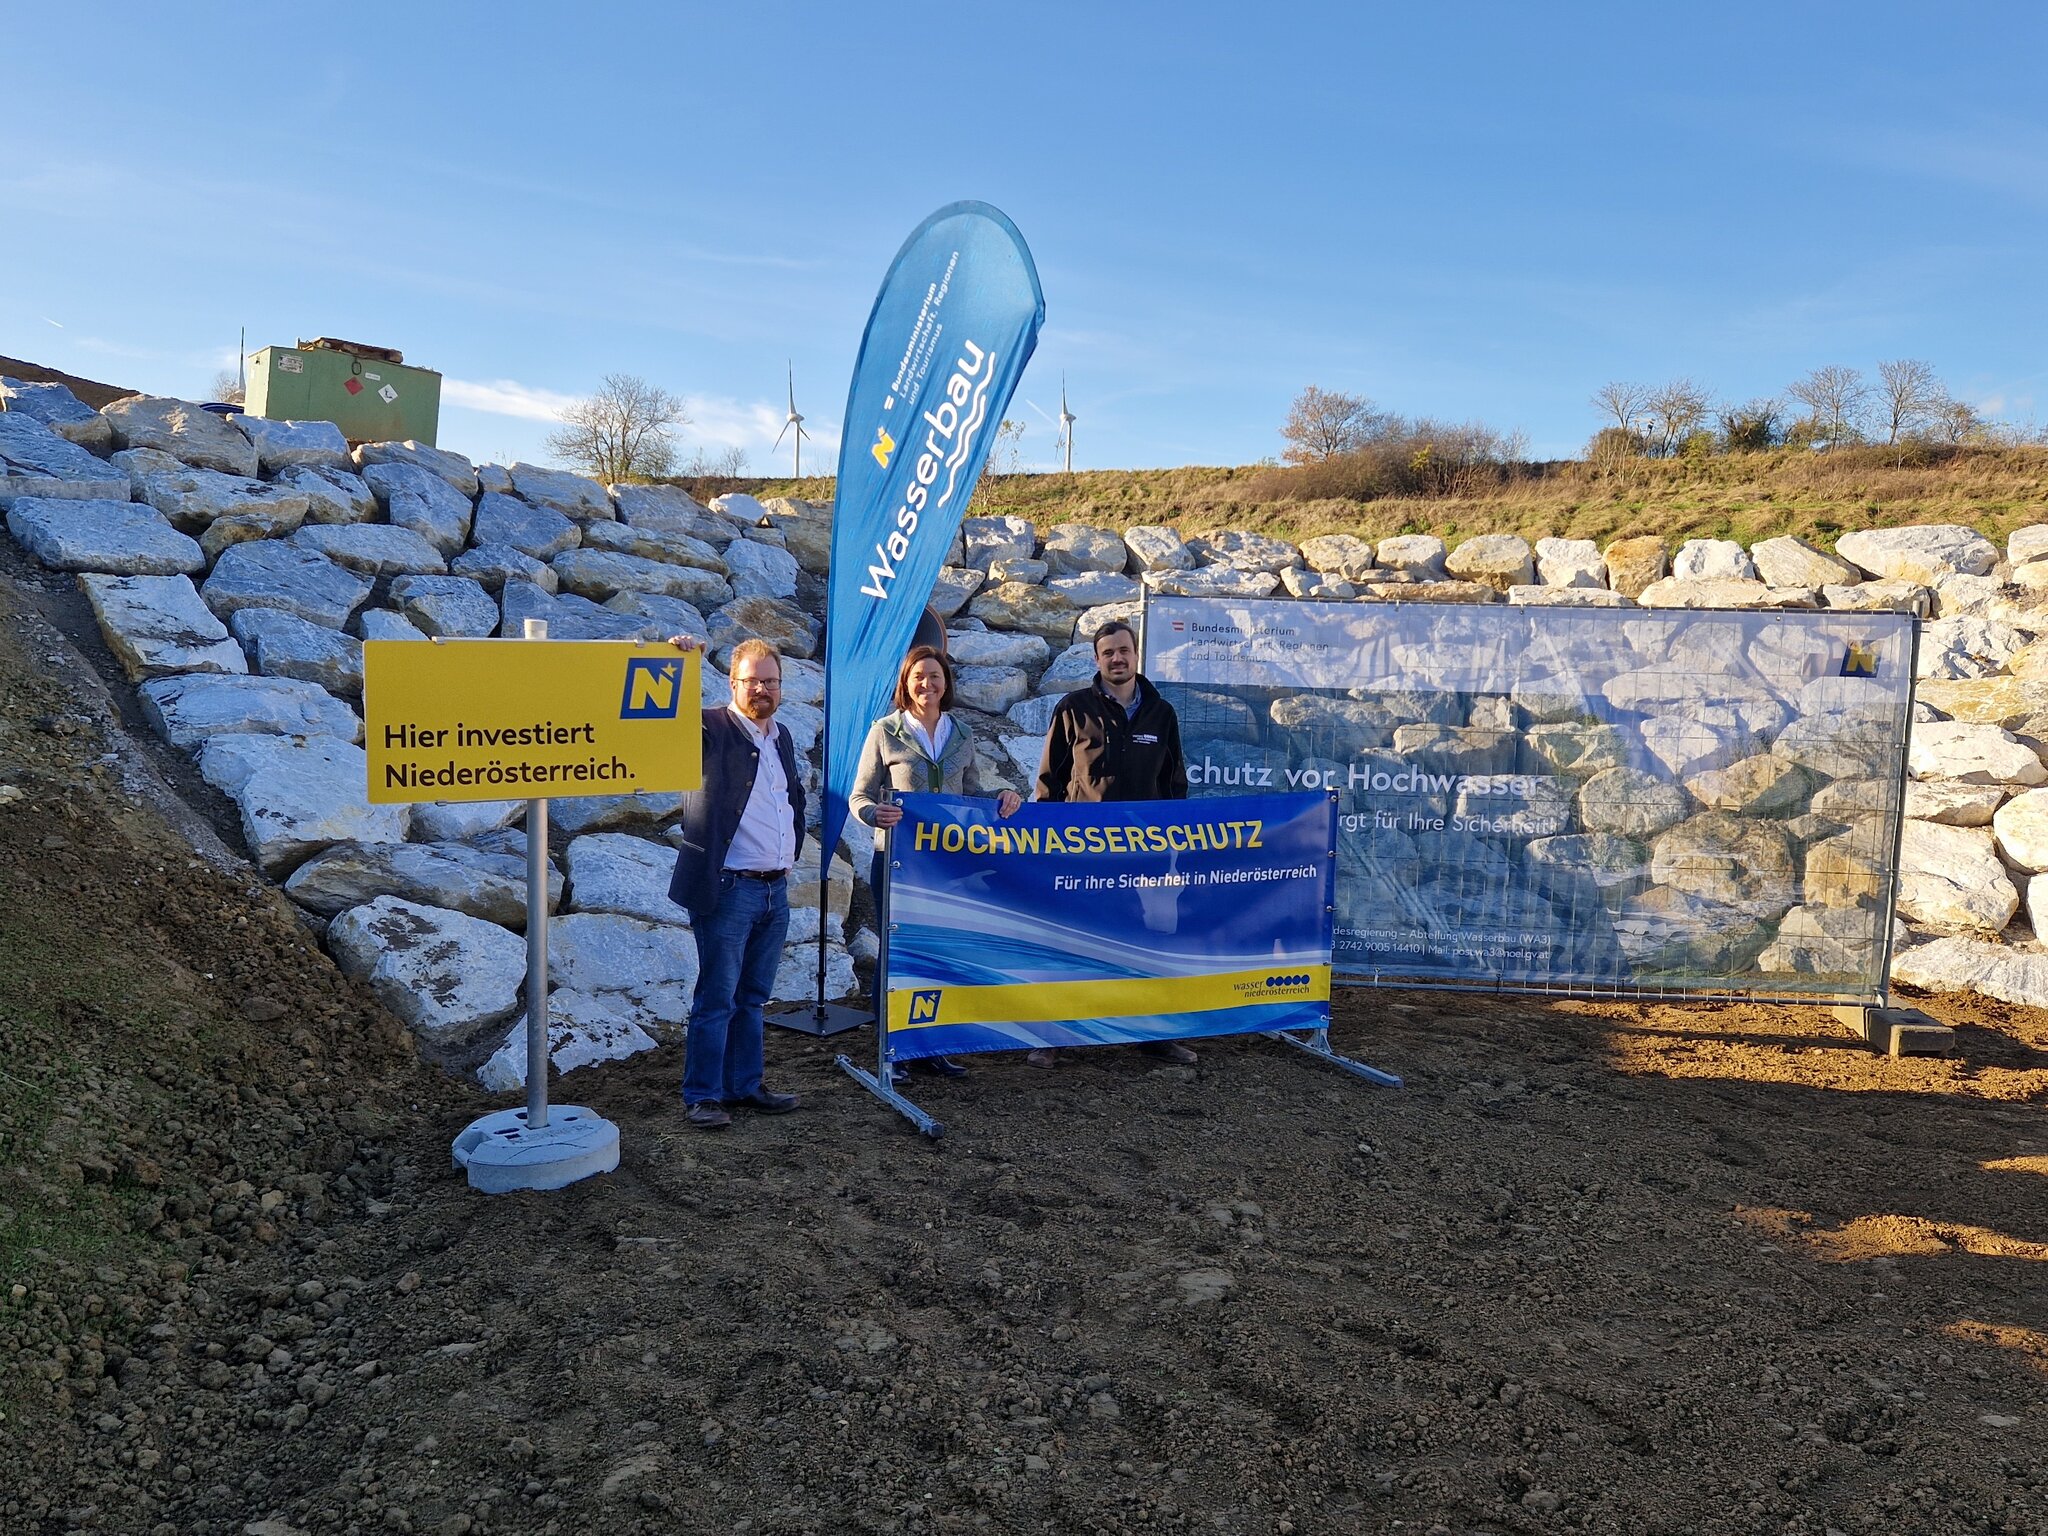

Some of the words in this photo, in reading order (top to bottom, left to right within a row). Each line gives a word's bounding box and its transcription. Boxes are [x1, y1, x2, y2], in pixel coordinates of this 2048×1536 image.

[892, 283, 937, 392] Bundesministerium
[899, 311, 939, 399] Landwirtschaft,
[933, 251, 959, 307] Regionen
[909, 381, 920, 405] und
[916, 323, 943, 379] Tourismus
[860, 339, 985, 600] Wasserbau
[384, 724, 449, 749] Hier
[457, 721, 596, 747] investiert
[385, 756, 637, 788] Niederösterreich.
[1186, 756, 1273, 787] chutz
[1285, 769, 1337, 790] vor
[1348, 763, 1543, 795] Hochwasser
[1339, 813, 1367, 832] rgt
[1374, 810, 1400, 829] für
[1408, 812, 1445, 831] Ihre
[914, 821, 1263, 854] HOCHWASSERSCHUTZ
[1054, 874, 1080, 891] Für
[1085, 874, 1115, 891] ihre
[1118, 871, 1190, 888] Sicherheit
[1194, 871, 1206, 886] in
[1210, 864, 1317, 885] Niederösterreich
[1333, 926, 1397, 939] desregierung
[1409, 928, 1458, 943] Abteilung
[1462, 931, 1516, 943] Wasserbau
[1520, 933, 1551, 945] (WA3)
[1339, 940, 1363, 951] 2742
[1364, 941, 1391, 952] 9005
[1392, 943, 1420, 954] 14410
[1233, 980, 1264, 991] wasser
[1244, 985, 1310, 998] niederösterreich
